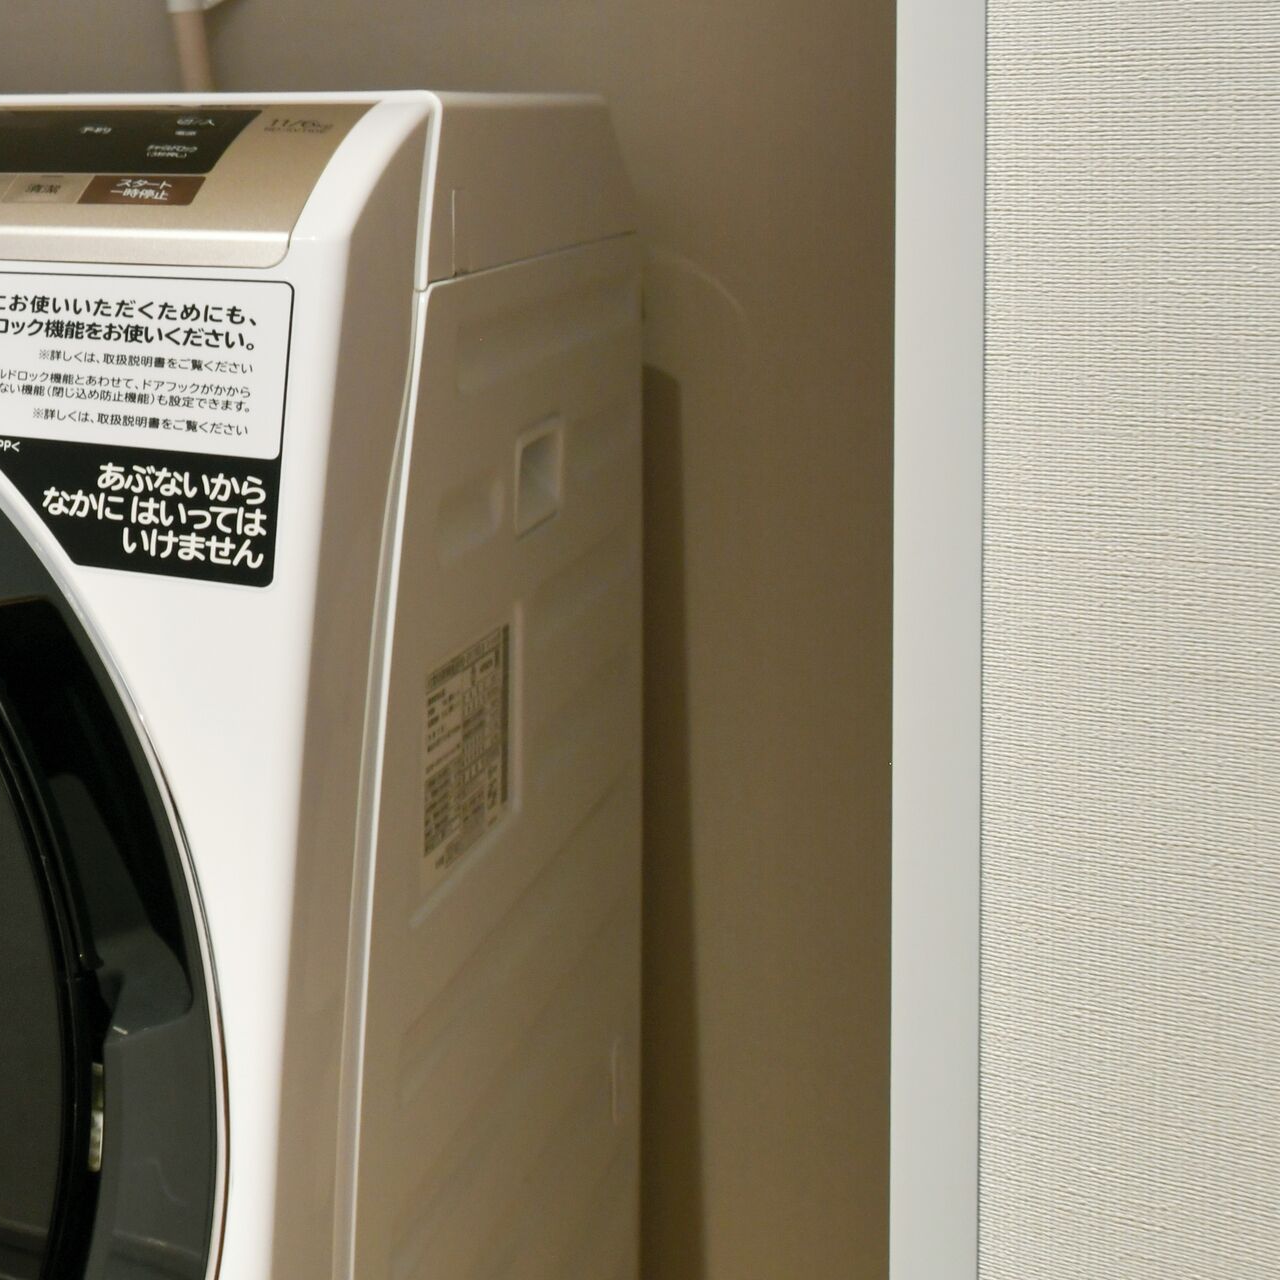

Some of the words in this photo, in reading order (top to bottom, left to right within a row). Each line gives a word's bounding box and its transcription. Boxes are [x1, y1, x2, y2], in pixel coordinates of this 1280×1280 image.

[110, 187, 169, 201] 一時停止
[116, 178, 172, 190] スタート
[96, 461, 267, 505] あぶないから
[122, 526, 265, 569] いけません
